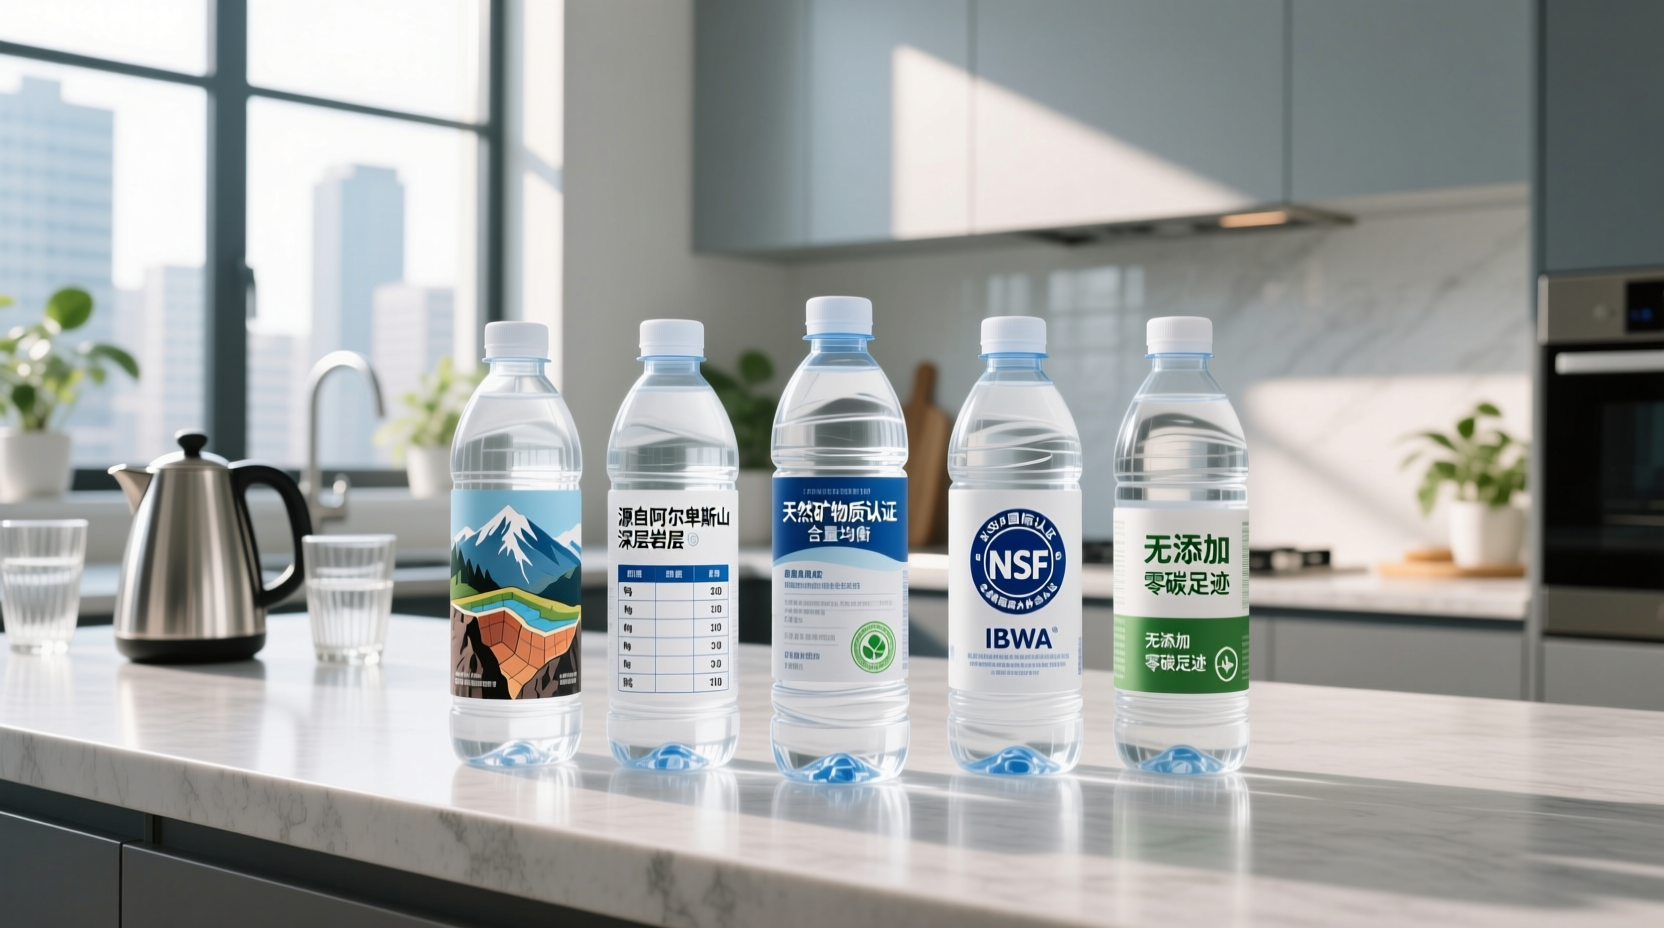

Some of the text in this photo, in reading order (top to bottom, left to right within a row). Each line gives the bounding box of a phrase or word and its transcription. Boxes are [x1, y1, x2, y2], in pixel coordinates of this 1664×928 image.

[618, 506, 730, 528] 源自阿尔卑斯山
[782, 500, 898, 523] 天然矿物质认证
[618, 529, 684, 550] 深层岩层
[1144, 533, 1230, 565] 无添加
[989, 549, 1049, 580] NSF
[1144, 570, 1230, 596] 零碳足迹
[985, 627, 1053, 650] IBWA
[1145, 632, 1190, 650] 无添加
